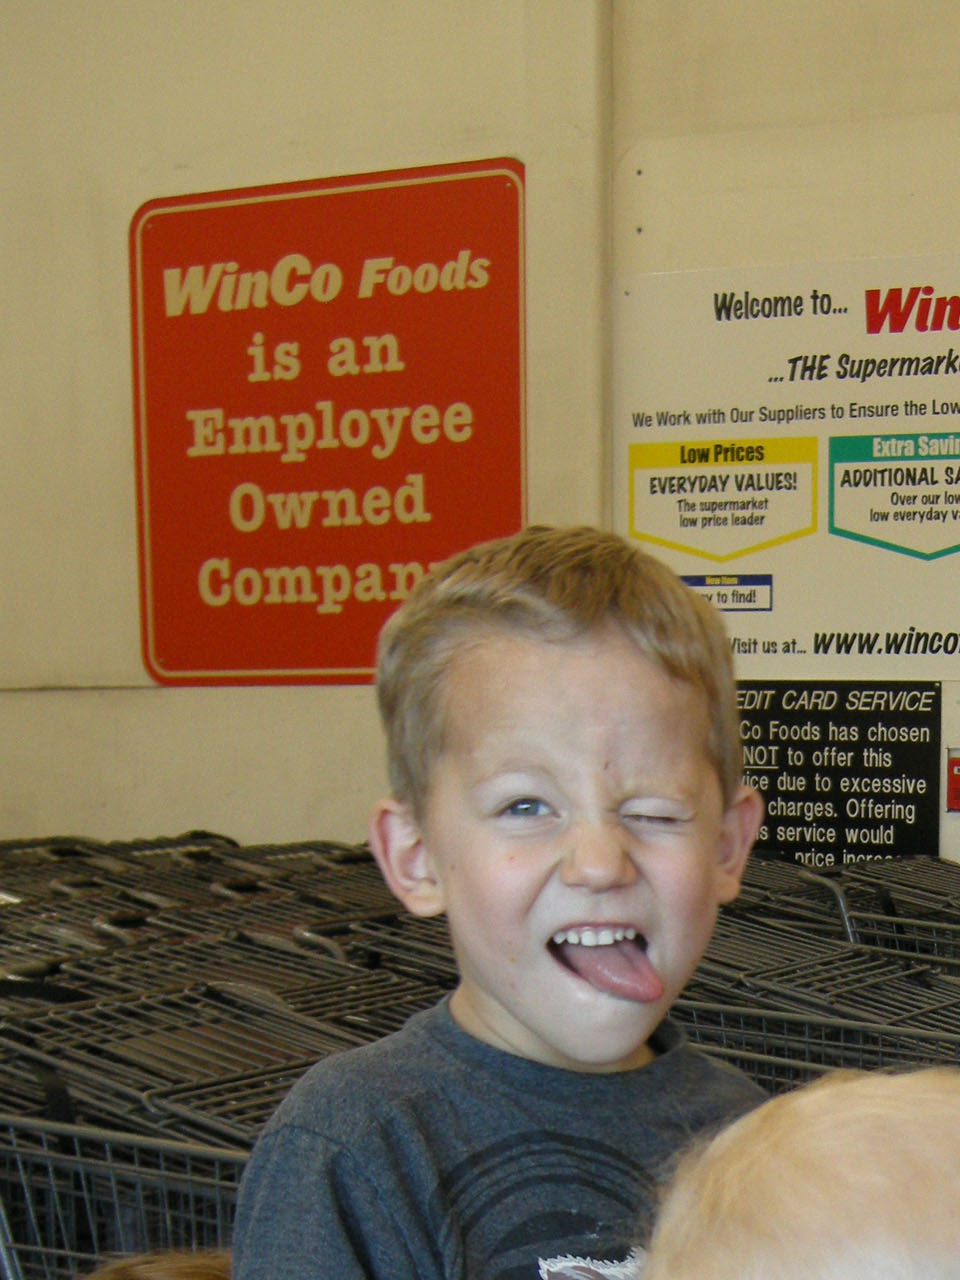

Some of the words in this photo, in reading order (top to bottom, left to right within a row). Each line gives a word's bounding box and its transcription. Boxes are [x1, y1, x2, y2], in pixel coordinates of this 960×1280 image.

[163, 255, 342, 317] WinCo
[357, 250, 491, 298] Foods
[713, 292, 804, 321] Welcome
[246, 332, 300, 382] is
[327, 332, 405, 376] an
[632, 412, 652, 427] We
[656, 410, 691, 427] Work
[696, 409, 725, 425] with
[730, 408, 755, 423] Our
[759, 405, 826, 425] Suppliers
[831, 404, 844, 419] to
[849, 402, 899, 418] Ensure
[904, 401, 927, 416] the
[186, 401, 473, 462] Employee
[680, 445, 710, 464] Low
[714, 444, 764, 463] Prices
[872, 437, 915, 458] Extra
[650, 475, 729, 495] EVERYDAY
[734, 472, 797, 492] VALUES!
[840, 466, 939, 488] ADDITIONAL
[229, 474, 431, 532] Owned
[677, 499, 696, 512] The
[700, 497, 768, 513] supermarket
[890, 492, 917, 506] Over
[921, 494, 941, 505] our
[679, 514, 697, 528] low
[701, 513, 728, 529] price
[731, 513, 765, 527] leader
[870, 508, 889, 522] low
[893, 507, 948, 523] everyday
[198, 558, 437, 613] Compan
[717, 591, 727, 604] to
[731, 590, 756, 603] find!
[762, 640, 777, 654] us
[782, 690, 838, 711] CARD
[845, 690, 936, 712] SERVICE
[769, 721, 820, 741] Foods
[828, 721, 858, 741] has
[868, 723, 930, 743] chosen
[743, 746, 779, 767] NOT
[787, 747, 804, 766] to
[812, 747, 854, 767] offer
[863, 747, 892, 767] this
[777, 771, 806, 791] due
[815, 773, 832, 792] to
[840, 774, 927, 794] excessive
[767, 797, 838, 821] charges.
[846, 798, 916, 824] Offering
[777, 823, 836, 843] service
[845, 824, 894, 844] would
